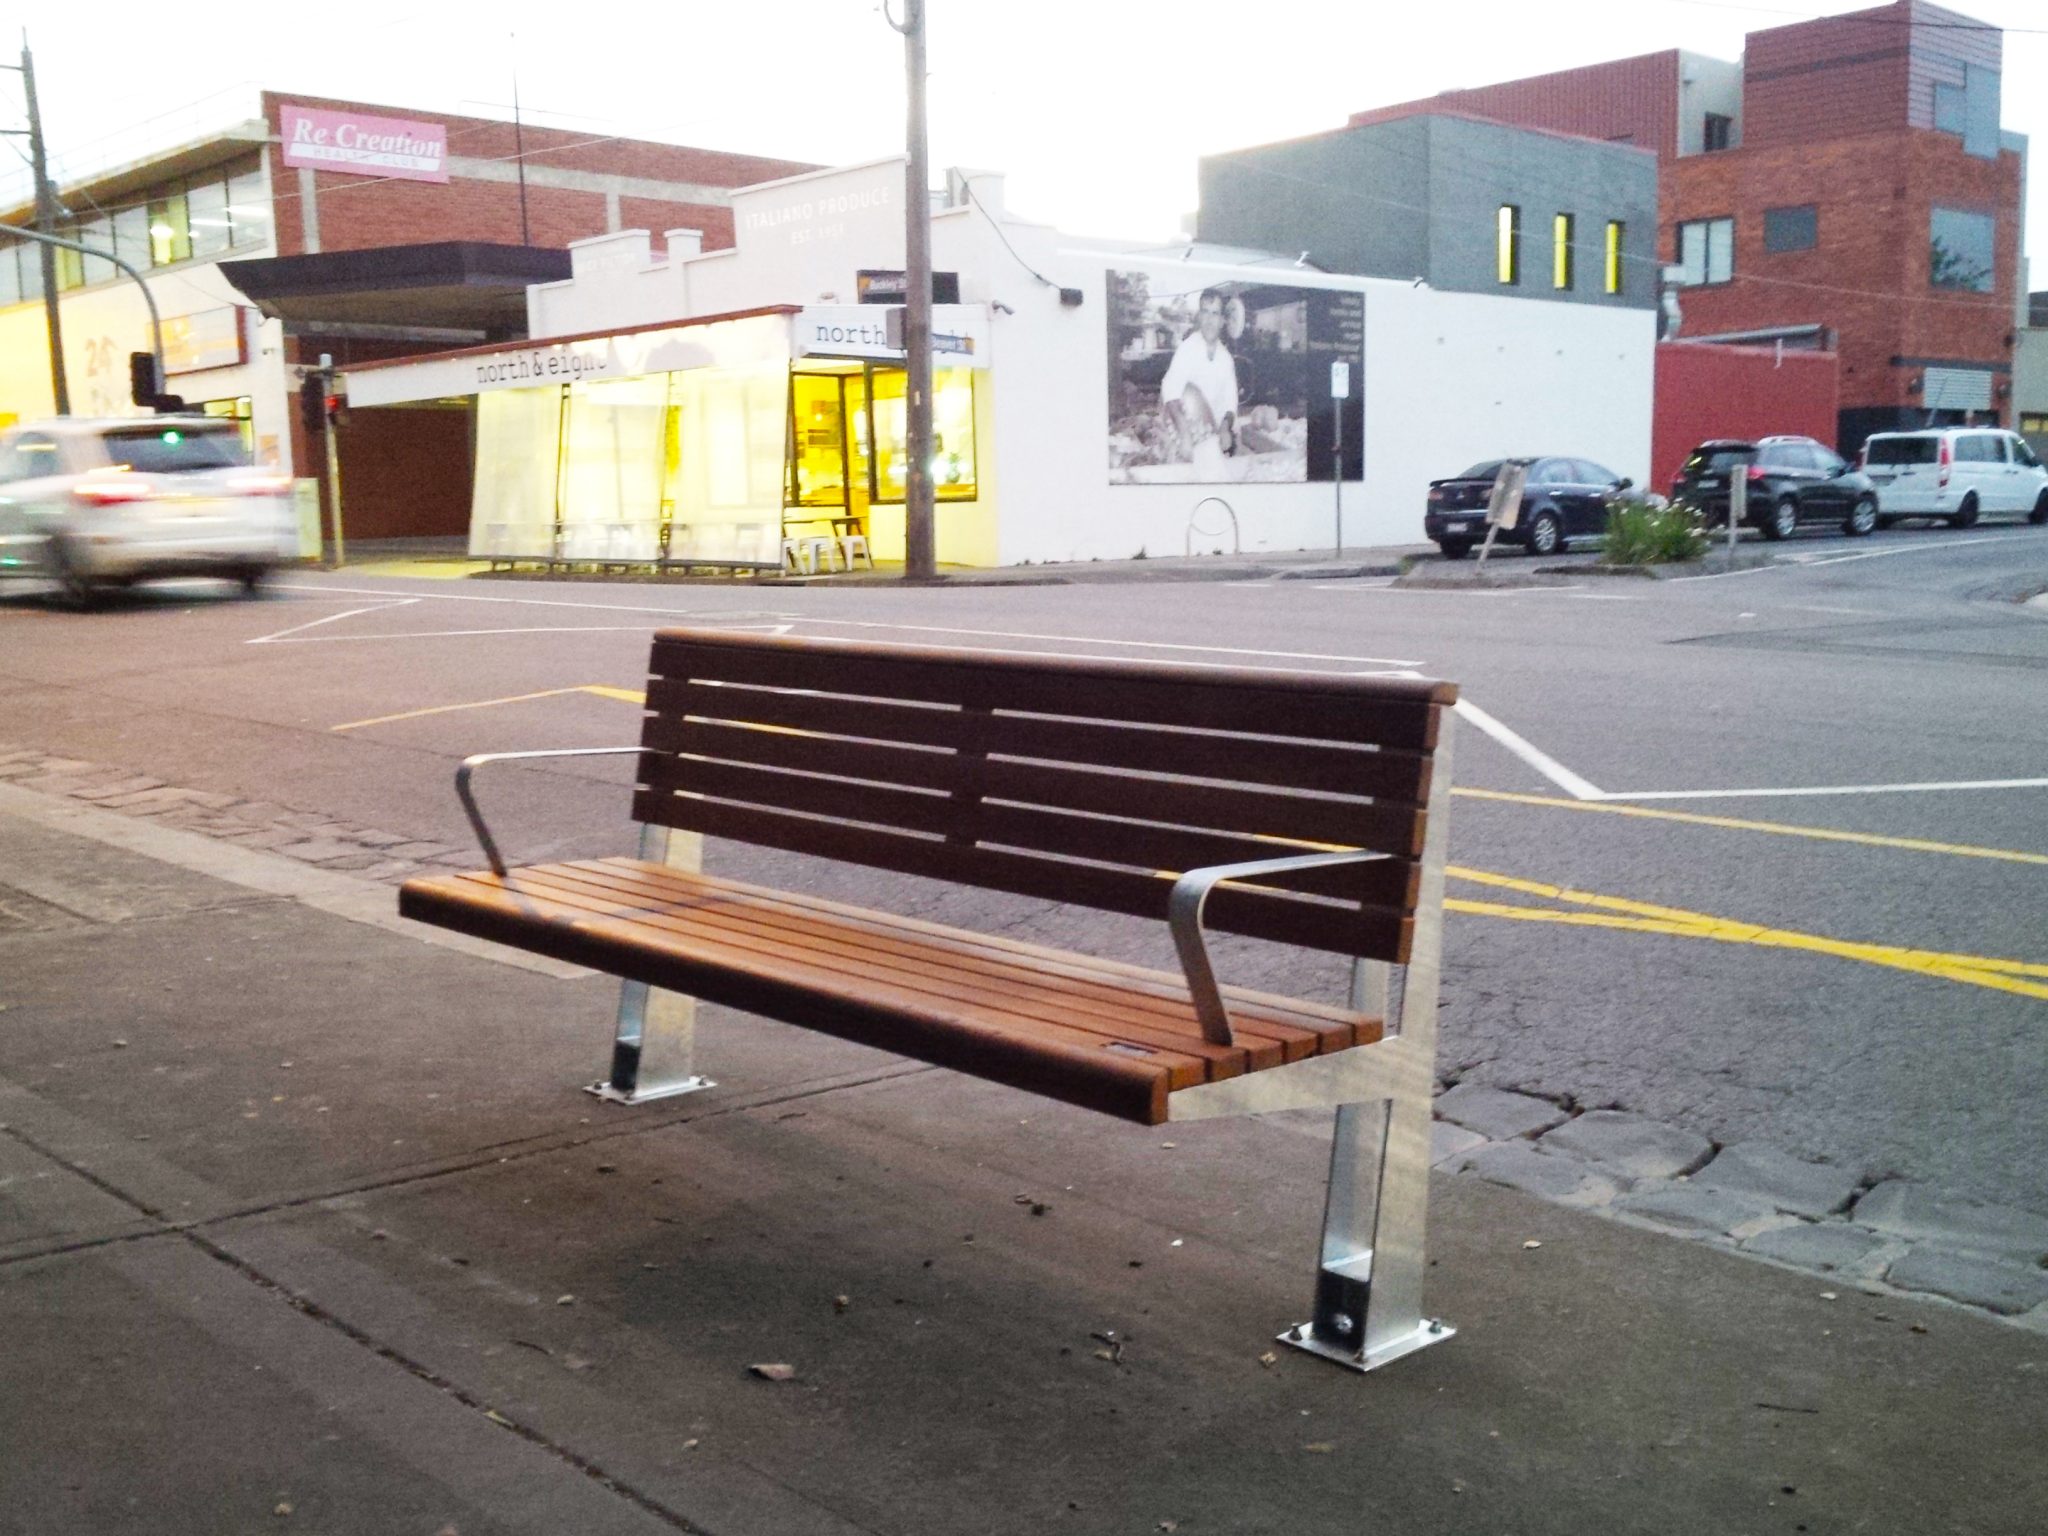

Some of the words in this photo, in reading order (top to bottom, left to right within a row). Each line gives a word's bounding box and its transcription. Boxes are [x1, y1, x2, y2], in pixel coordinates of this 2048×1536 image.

[293, 118, 328, 144] Re
[335, 123, 442, 158] Creation
[745, 202, 813, 230] ITALIANO
[818, 186, 889, 216] PRODUCE
[816, 325, 886, 345] north
